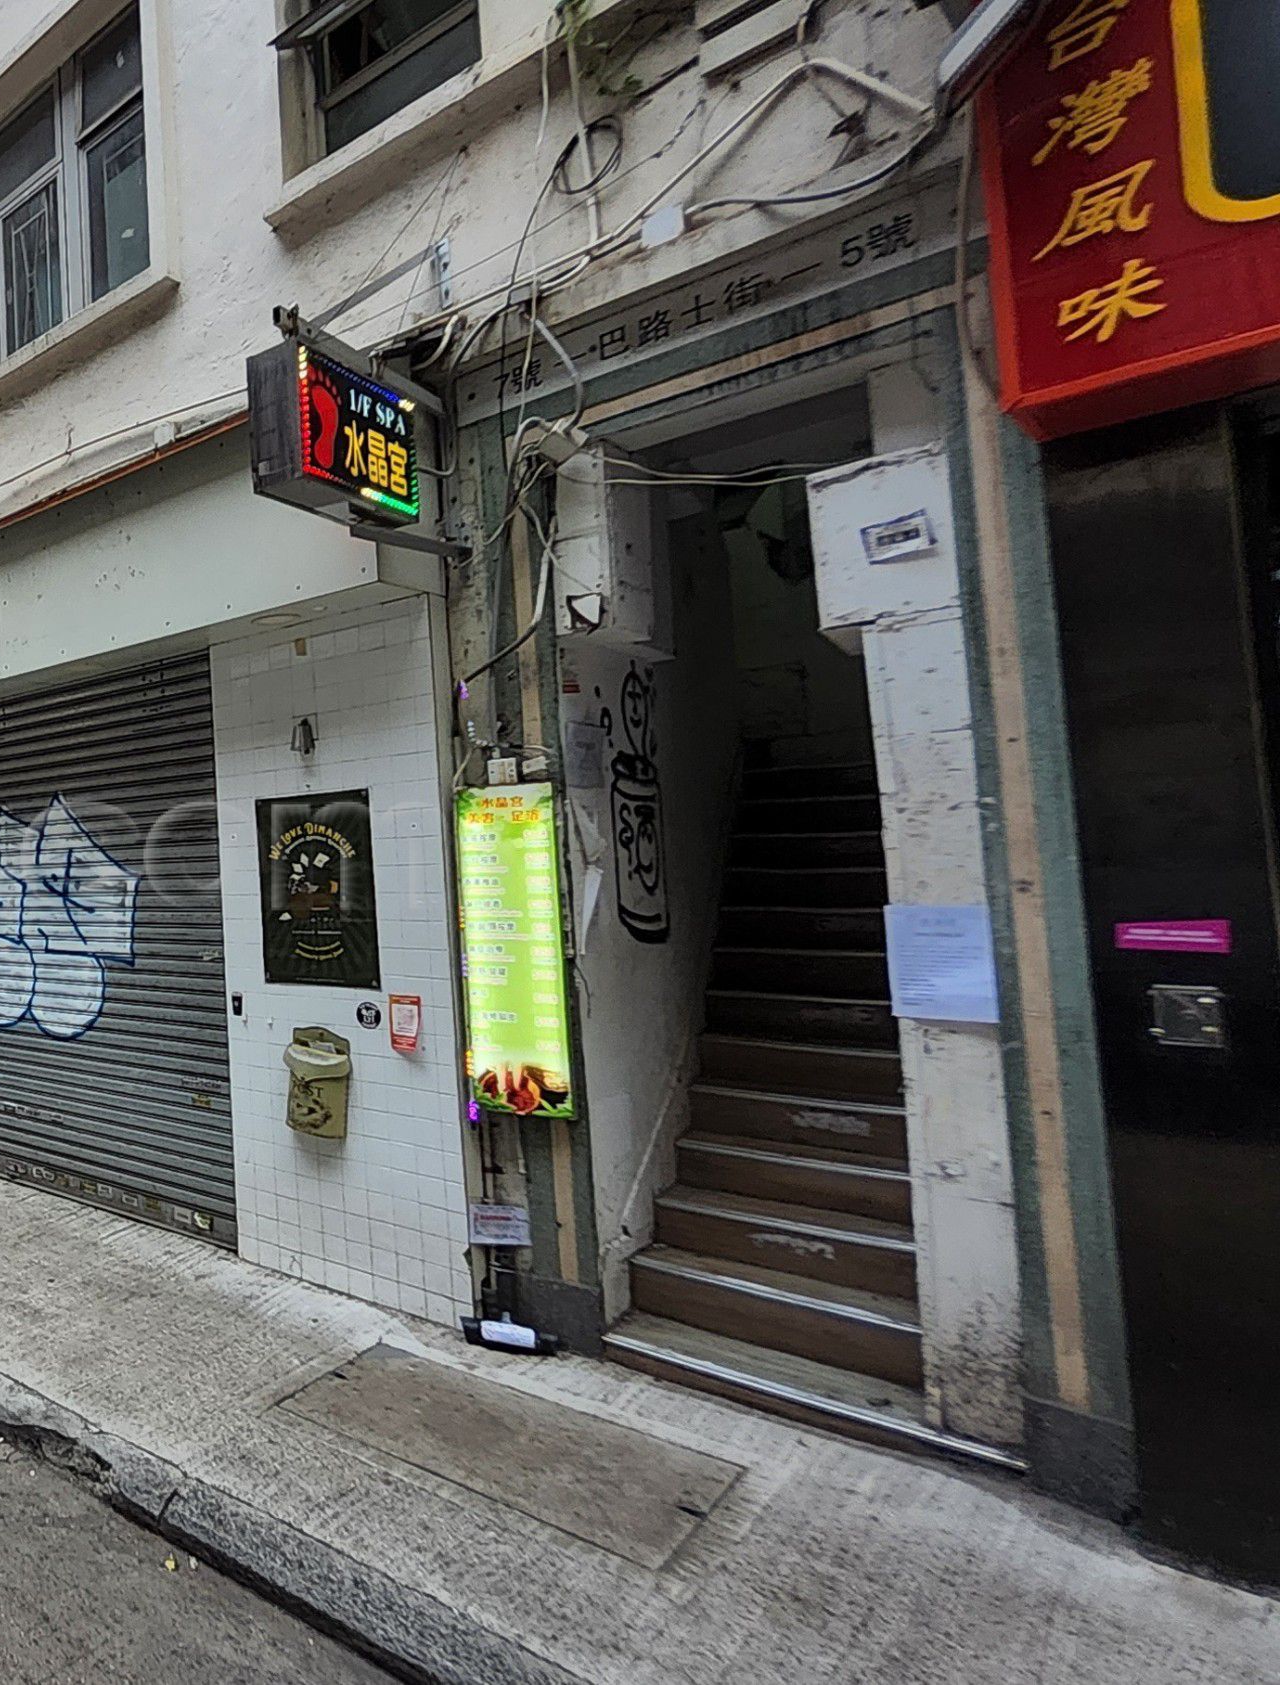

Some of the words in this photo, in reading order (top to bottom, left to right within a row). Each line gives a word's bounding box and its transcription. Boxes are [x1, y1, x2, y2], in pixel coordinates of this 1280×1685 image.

[1031, 0, 1168, 343] 台灣風味
[599, 272, 763, 360] 巴路士街
[839, 212, 915, 271] 5號
[344, 419, 408, 496] 水晶宮
[349, 388, 373, 418] 1/F
[375, 401, 407, 436] SPA
